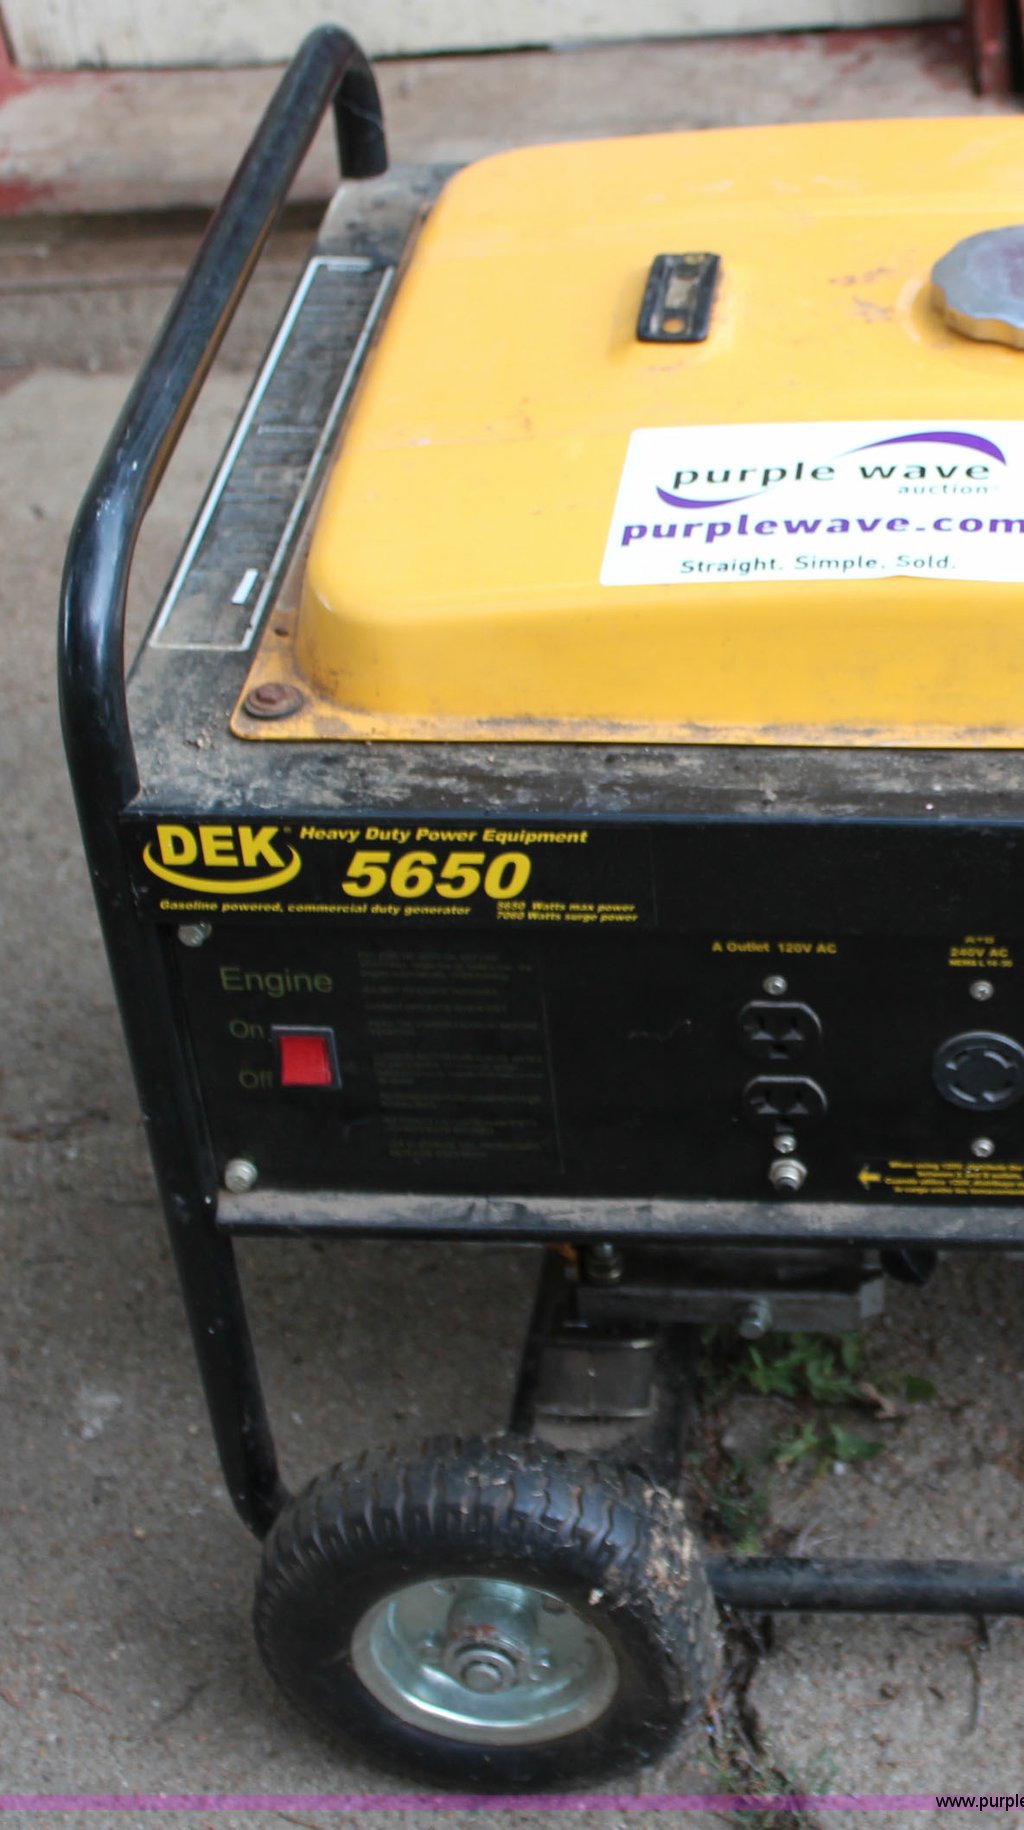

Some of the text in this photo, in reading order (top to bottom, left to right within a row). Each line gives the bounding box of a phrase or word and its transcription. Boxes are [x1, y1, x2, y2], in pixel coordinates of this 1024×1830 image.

[672, 461, 990, 490] purple wave
[897, 482, 988, 495] auction
[680, 552, 957, 576] Straight. Simple. Sold.
[300, 825, 590, 845] Heavy Duty Power Equipment
[156, 825, 285, 868] DEK
[341, 850, 532, 899] 5650
[159, 898, 472, 917] Gasoline powered, commercial duty generator
[527, 911, 562, 921] Watts
[599, 913, 640, 923] power
[531, 901, 567, 912] Watts
[596, 903, 636, 913] power
[711, 941, 838, 955] A Outlet 120V AC
[989, 948, 1010, 959] AC
[219, 966, 333, 998] Engine
[229, 1018, 264, 1040] On
